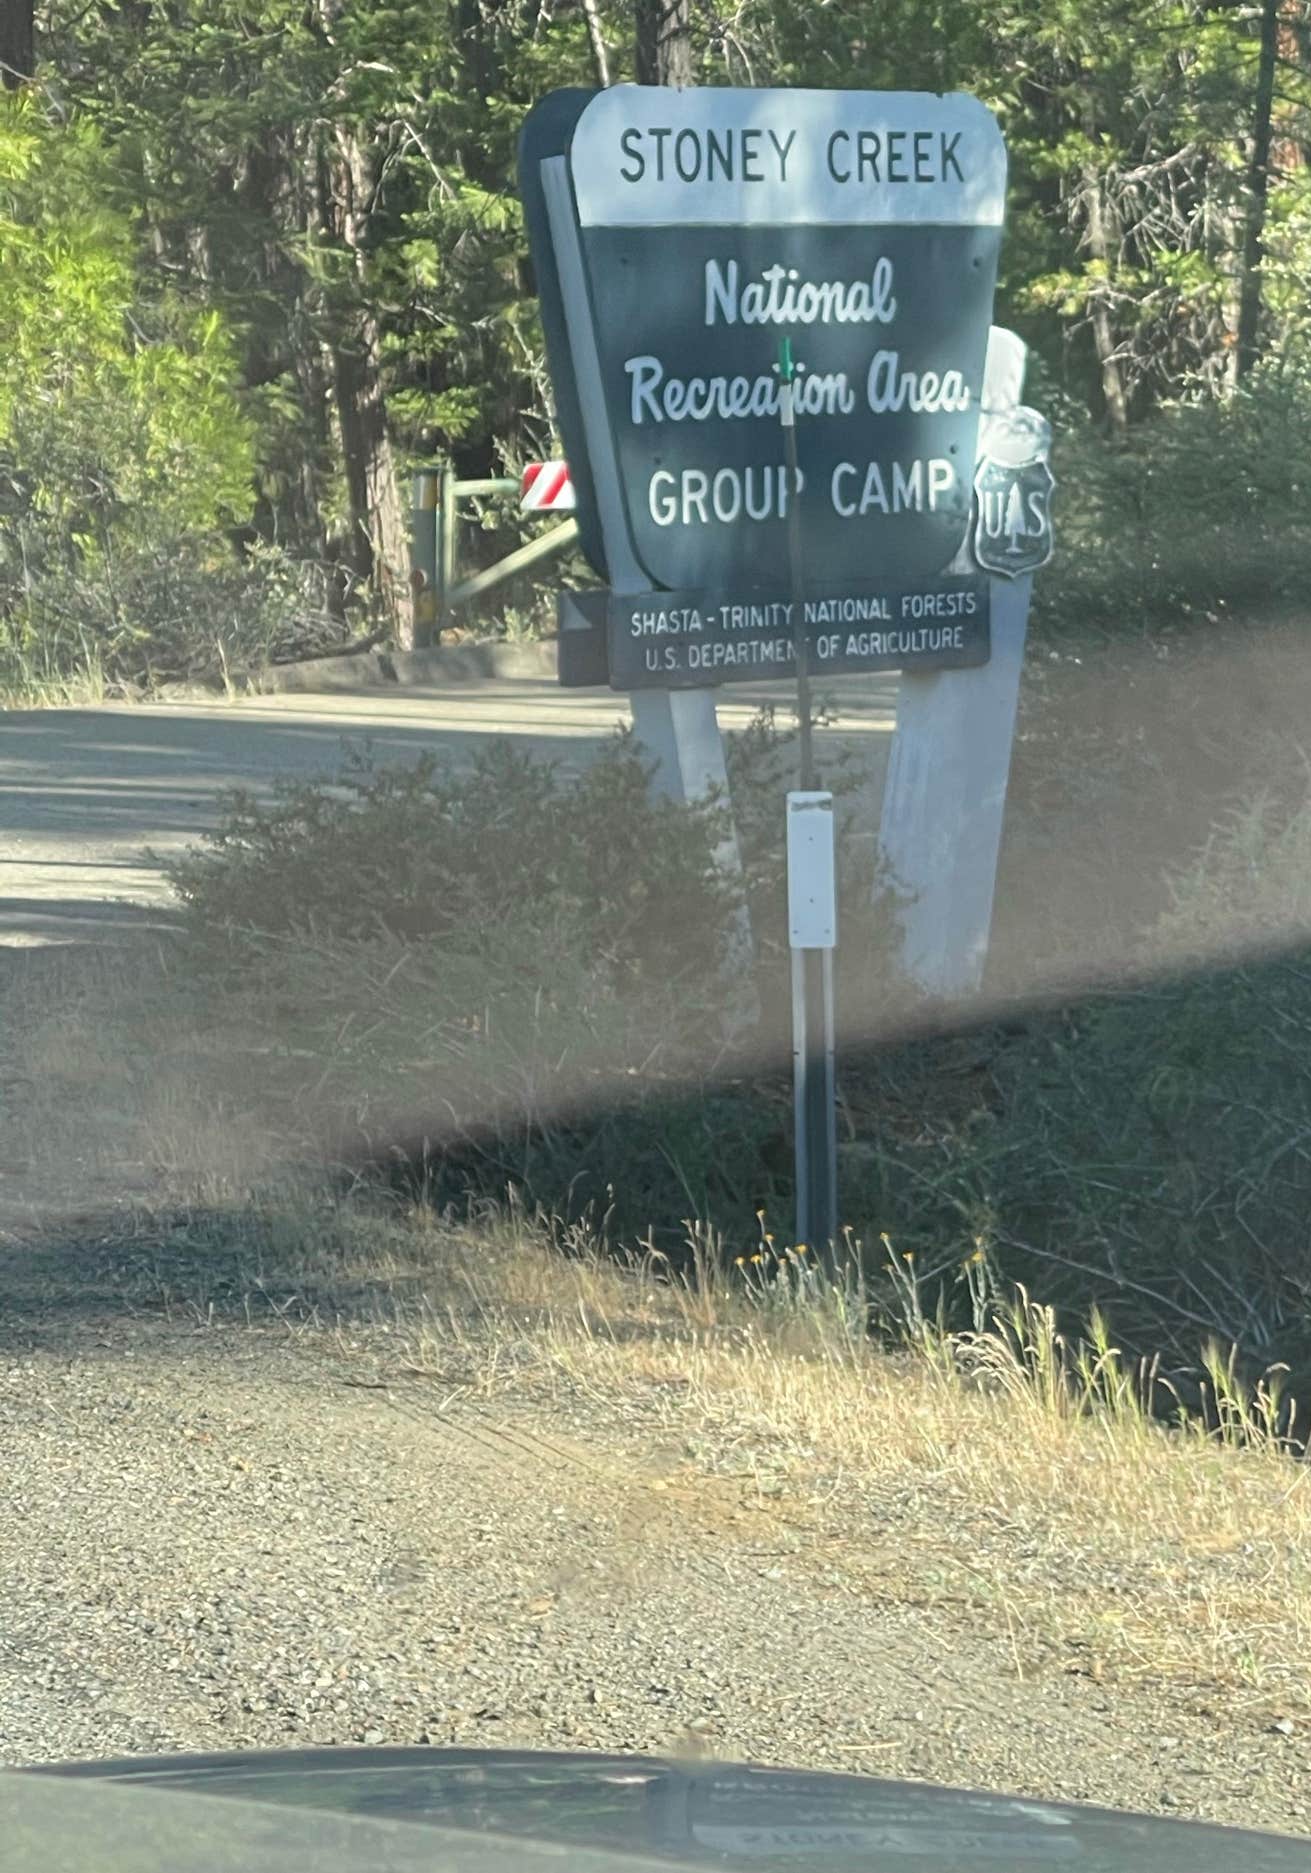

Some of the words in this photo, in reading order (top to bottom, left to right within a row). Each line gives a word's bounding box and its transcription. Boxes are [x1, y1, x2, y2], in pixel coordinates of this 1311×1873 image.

[619, 127, 797, 184] STONEY
[826, 129, 965, 184] CREEK
[705, 256, 898, 326] National
[867, 350, 971, 415] Area
[648, 464, 804, 526] GROUP
[831, 458, 955, 517] CAMP
[803, 597, 891, 625] NATIONAL
[902, 591, 977, 618] FORESTS
[646, 648, 680, 671] U.S.
[687, 635, 810, 668] DEPARTMEN
[816, 633, 838, 659] OF
[845, 625, 964, 656] AGRICULTURE
